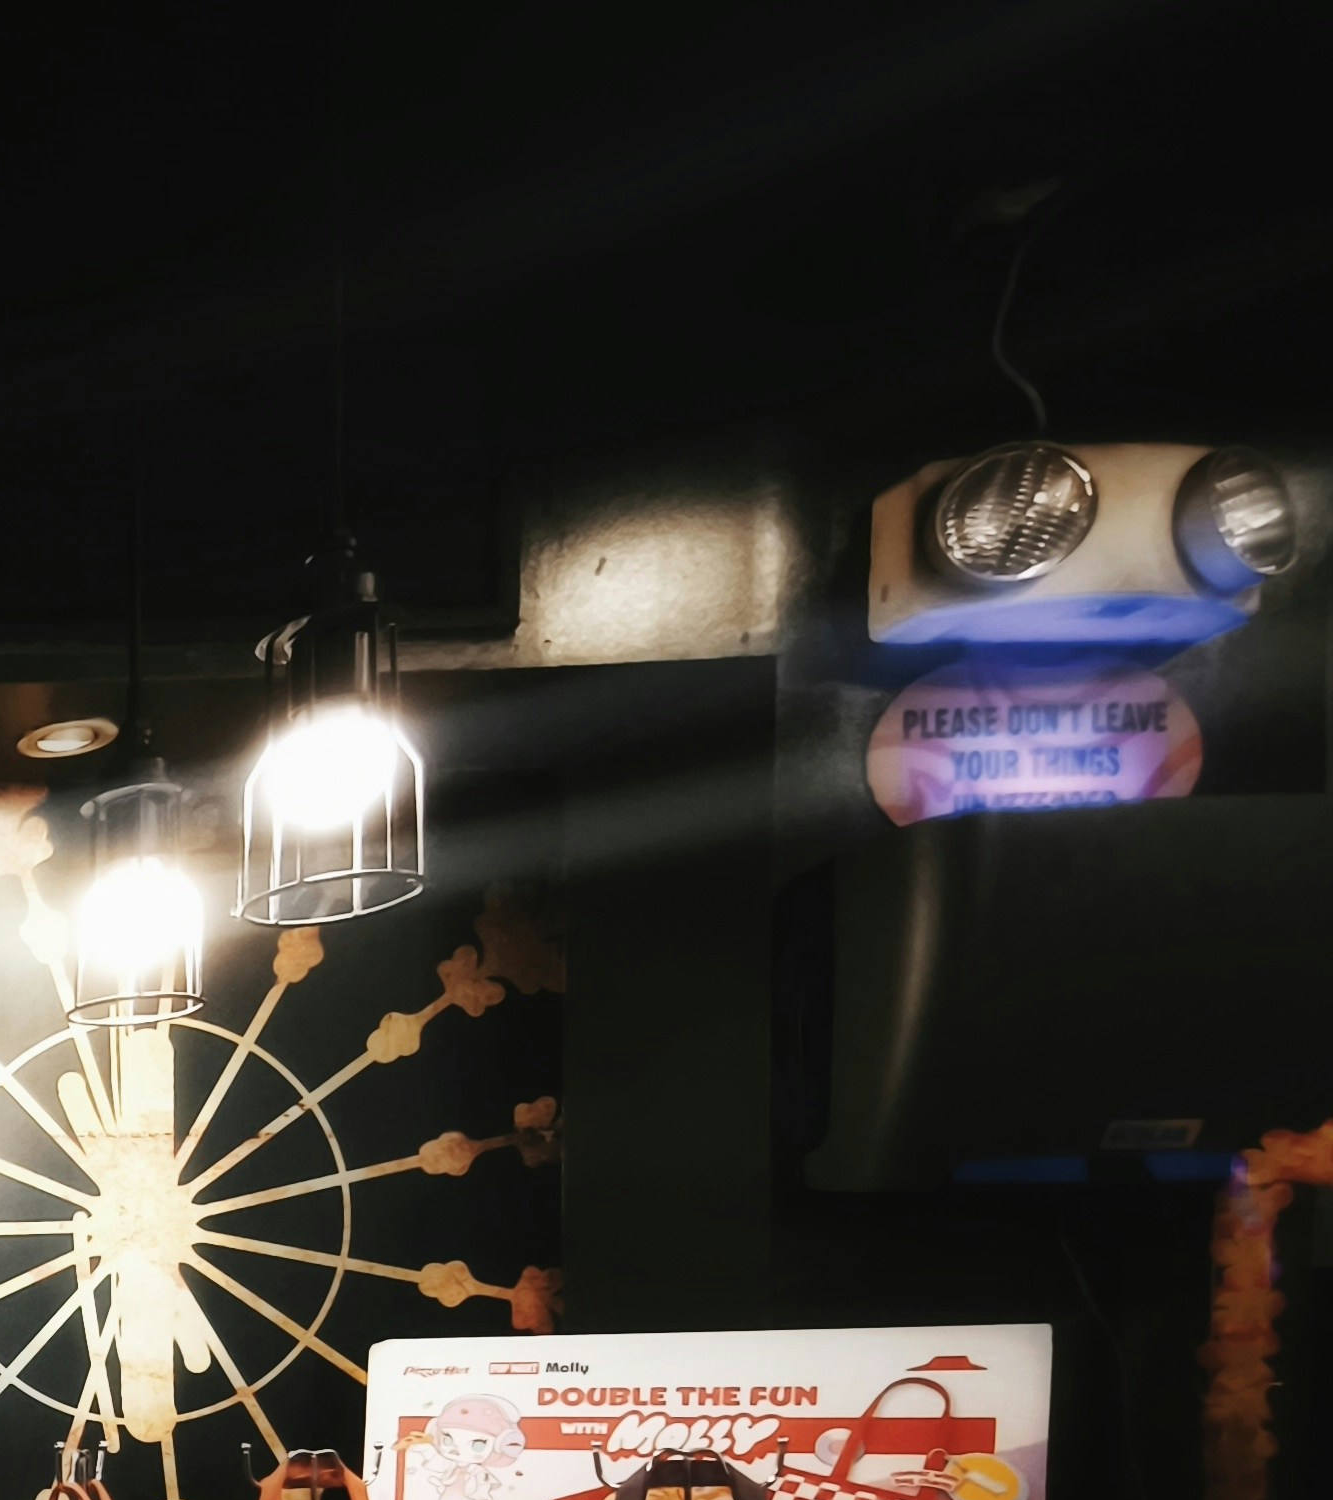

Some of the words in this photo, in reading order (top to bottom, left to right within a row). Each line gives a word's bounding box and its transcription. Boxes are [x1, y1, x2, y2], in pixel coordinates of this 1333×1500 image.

[902, 706, 999, 740] PLEASE
[1007, 703, 1084, 736] DON'T
[1091, 701, 1169, 734] LEAVE
[951, 750, 1021, 781] YOUR
[1029, 746, 1121, 779] THINGS
[545, 1362, 589, 1375] Molly
[537, 1386, 667, 1406] DOUBLE
[676, 1386, 741, 1406] THE
[749, 1386, 818, 1406] FUN
[559, 1421, 608, 1435] WITH
[606, 1413, 781, 1455] MOLLY
